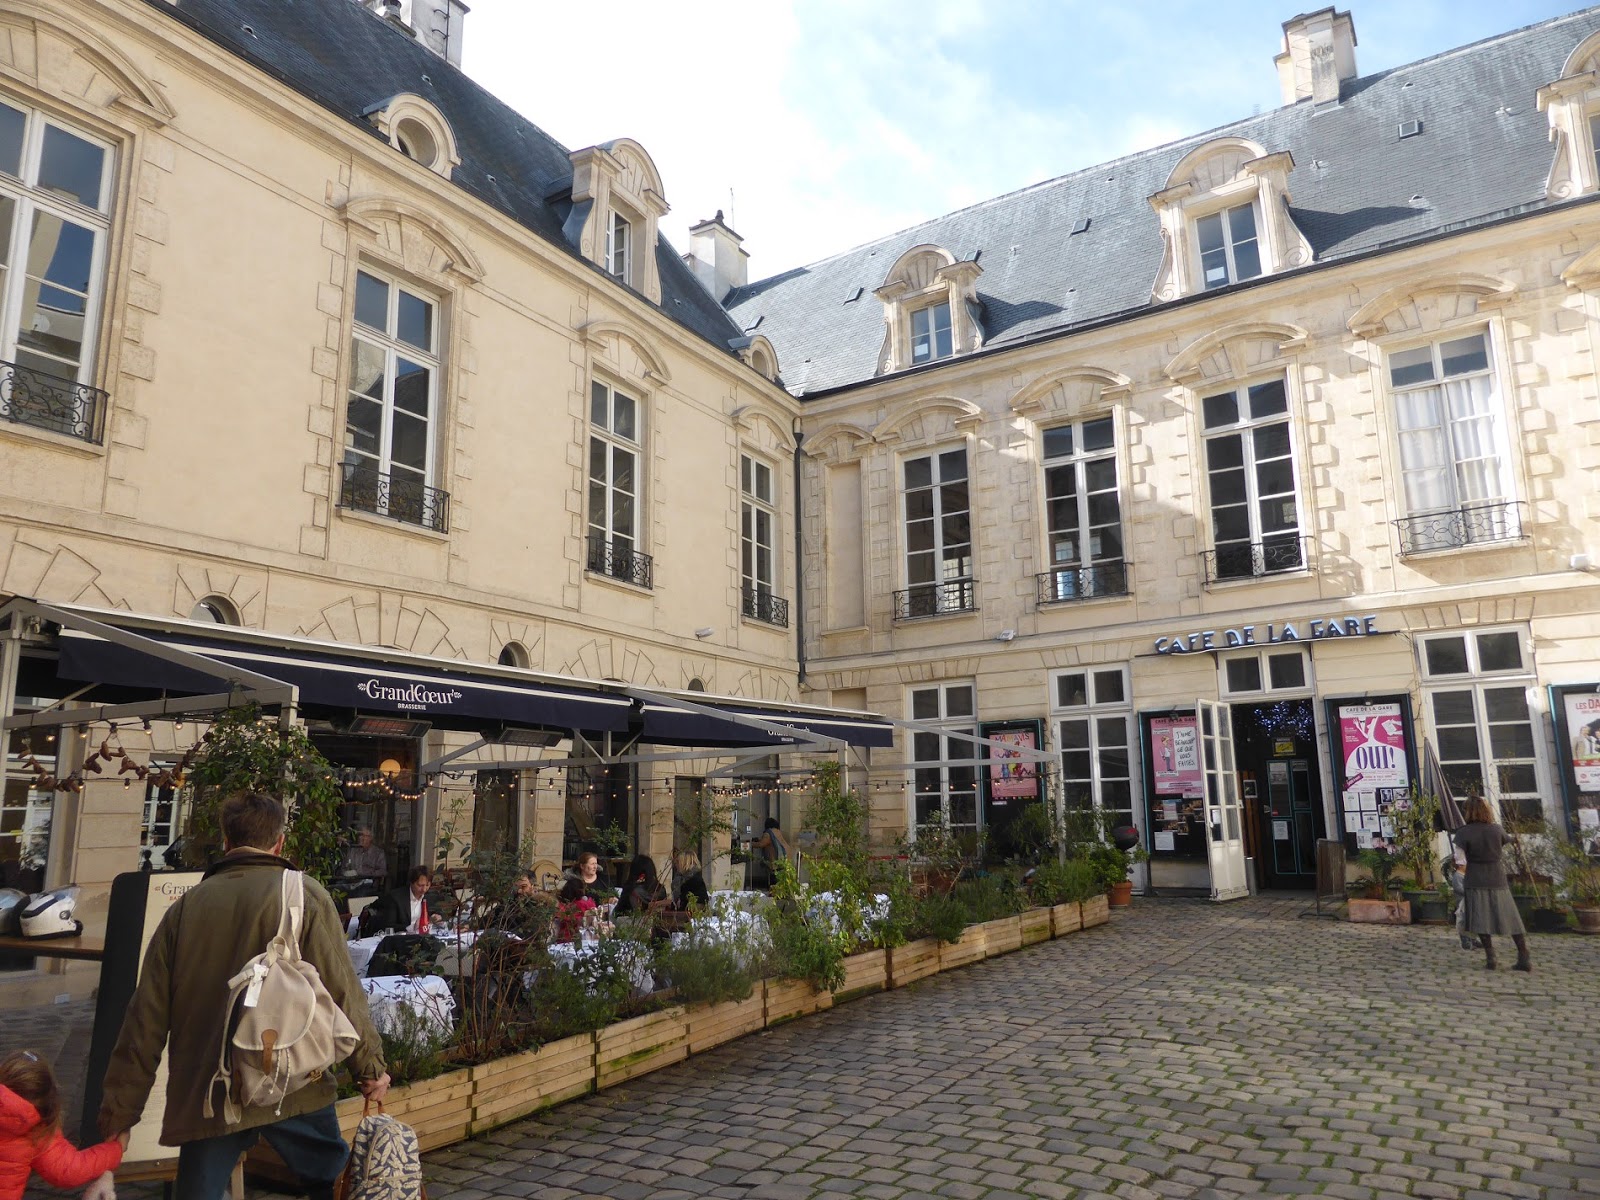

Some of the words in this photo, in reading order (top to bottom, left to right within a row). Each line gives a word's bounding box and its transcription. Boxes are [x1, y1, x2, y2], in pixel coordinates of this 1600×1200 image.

[1154, 630, 1215, 654] CAFE
[1225, 625, 1255, 647] DE
[1267, 622, 1298, 643] LA
[1310, 614, 1379, 638] GARE
[397, 703, 427, 711] BRASSERIE
